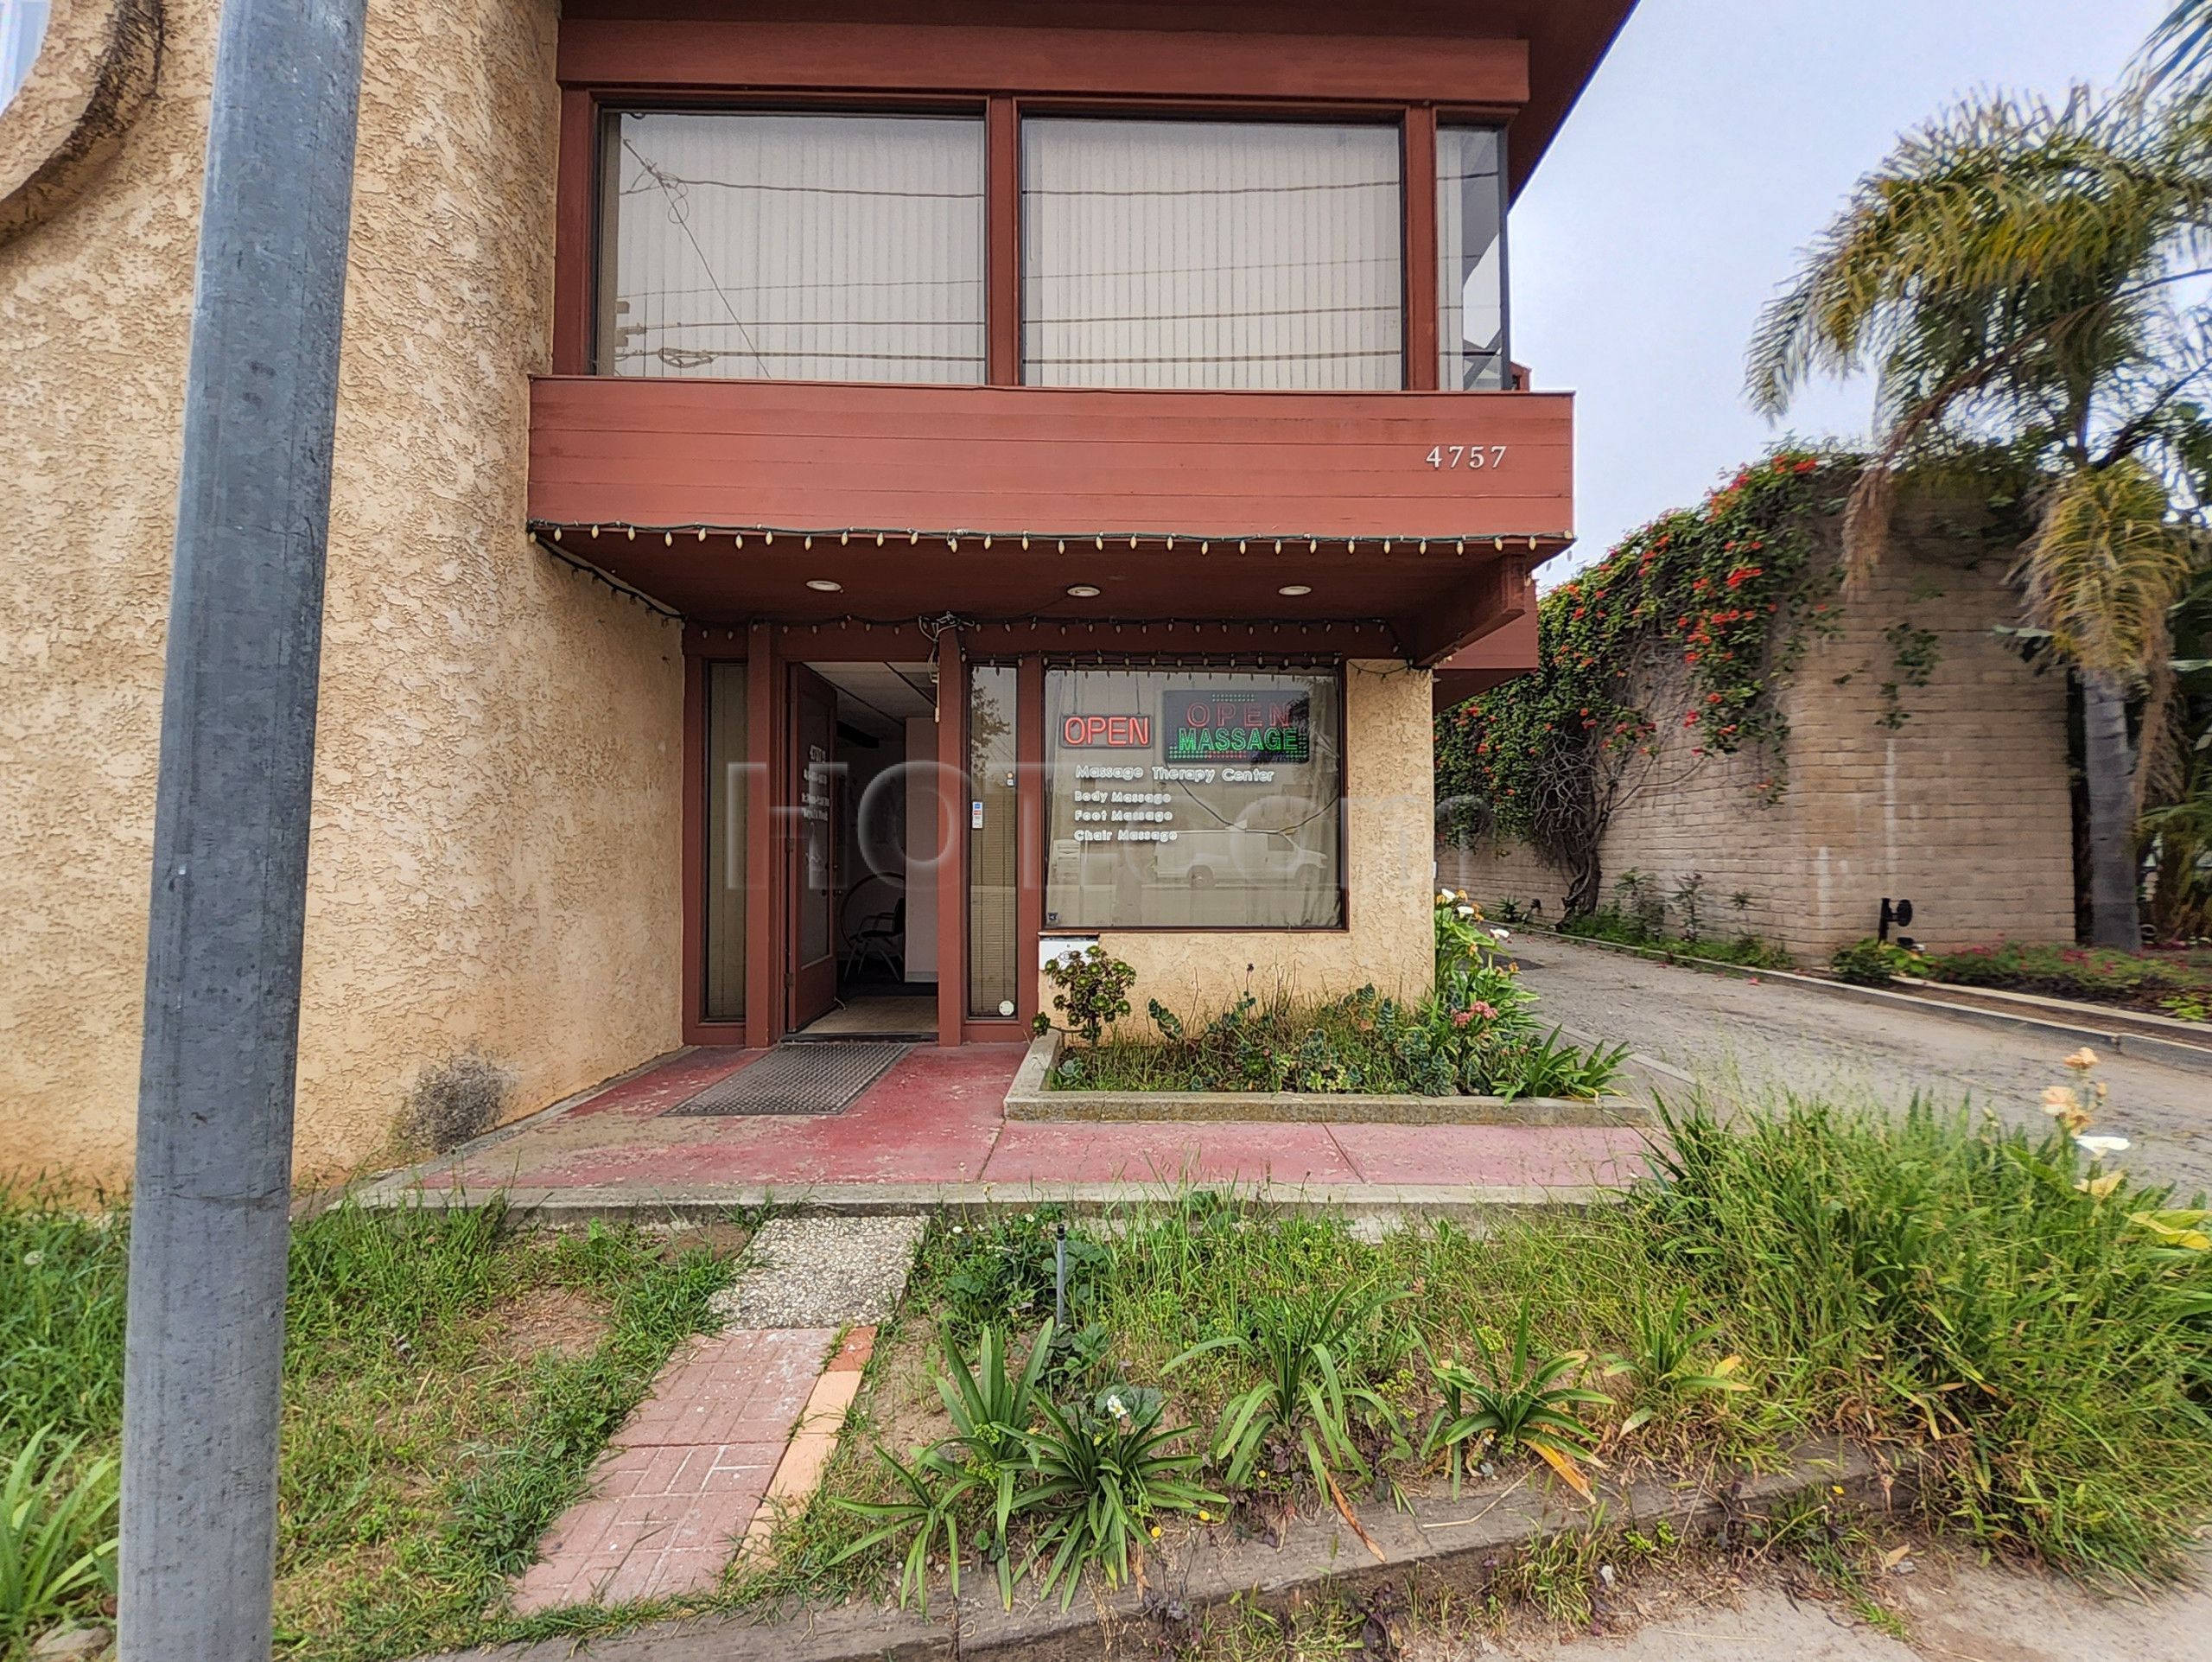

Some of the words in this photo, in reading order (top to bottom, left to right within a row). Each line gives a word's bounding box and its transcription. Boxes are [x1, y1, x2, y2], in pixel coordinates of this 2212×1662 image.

[1426, 445, 1507, 468] 4757
[1186, 702, 1290, 728] OPEN
[1064, 716, 1149, 746] OPEN
[1178, 727, 1299, 751] MASSAGE
[1075, 764, 1144, 781] Massage
[1151, 766, 1215, 784] Therapy
[1221, 767, 1274, 782] Center
[1074, 790, 1108, 804] Body
[1110, 791, 1172, 805] Massage
[1074, 809, 1107, 822] Foot
[1110, 810, 1173, 823] Massage
[1073, 830, 1113, 842] Chair
[1117, 829, 1178, 843] Massage
